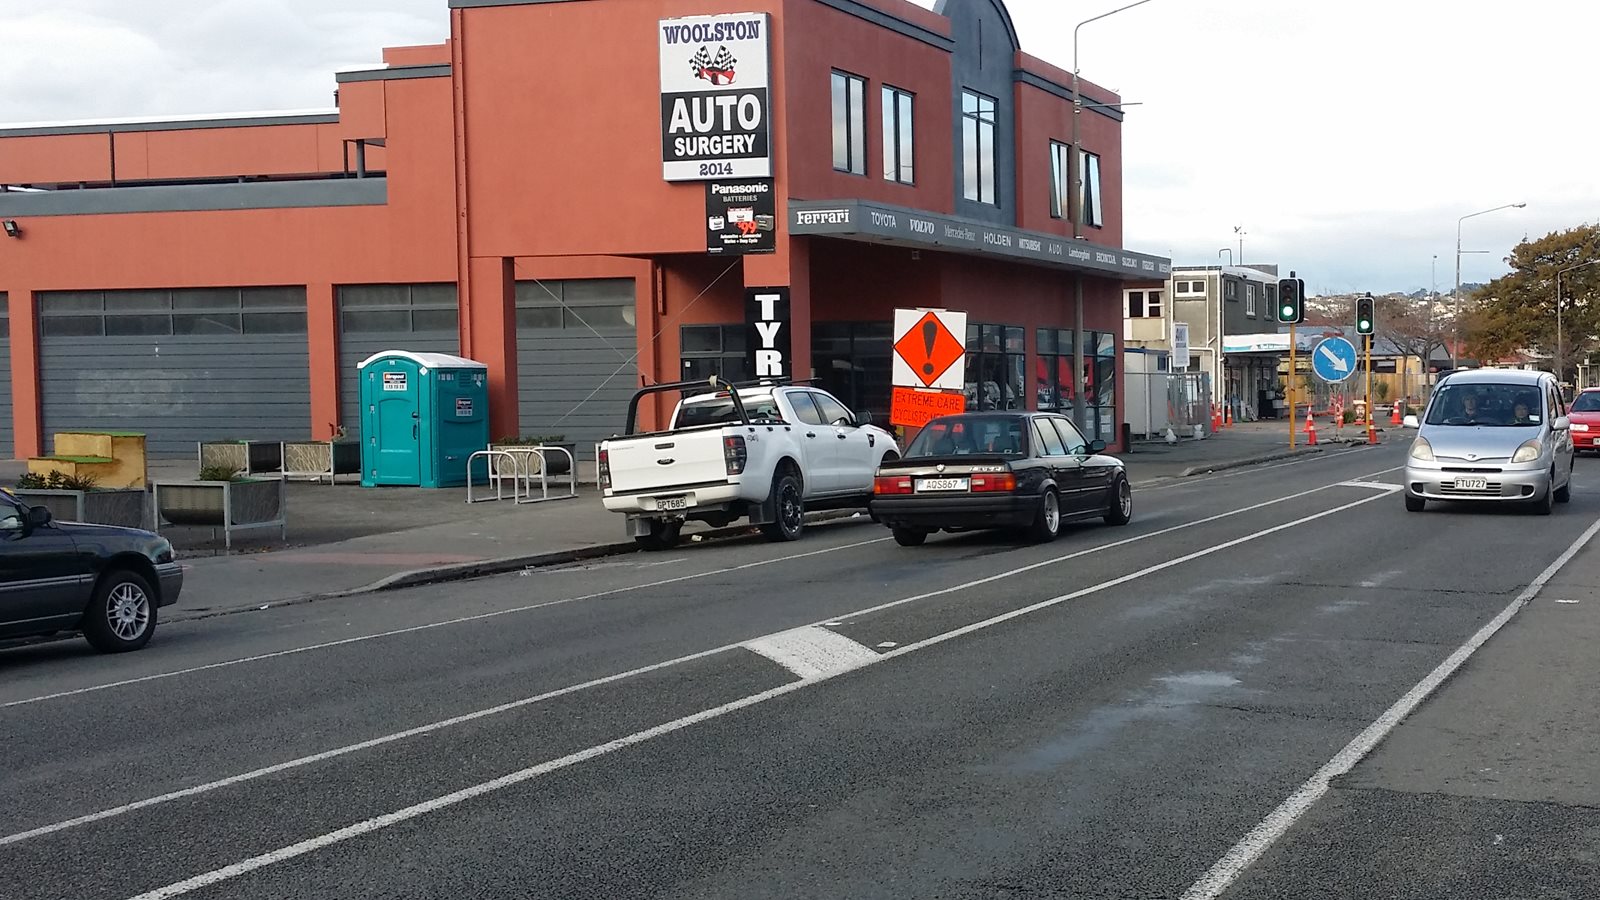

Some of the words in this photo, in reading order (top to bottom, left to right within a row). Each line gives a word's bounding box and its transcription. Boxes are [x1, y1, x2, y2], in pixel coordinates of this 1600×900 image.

[662, 20, 761, 45] WOOLSTON
[668, 94, 762, 134] AUTO
[674, 134, 756, 156] SURGERY
[699, 162, 733, 176] 2014
[711, 182, 769, 195] Panasonic
[796, 208, 850, 225] Ferrari
[870, 211, 897, 228] TOYOTA
[909, 218, 935, 235] VOLVO
[944, 224, 976, 242] Mercedes-Benz
[983, 232, 1012, 247] HOLDEN
[1018, 238, 1041, 252] MITSUBISHI
[1048, 243, 1062, 256] AUDI
[1095, 252, 1117, 265] HONDA
[1121, 256, 1138, 268] SUZUKI
[754, 294, 783, 385] TYR
[895, 391, 934, 407] EXTREME
[936, 397, 960, 411] CARE
[893, 408, 928, 423] CYCLISTS
[926, 480, 958, 489] AQS867
[1455, 479, 1486, 488] FTU727
[657, 499, 685, 509] GPT685
